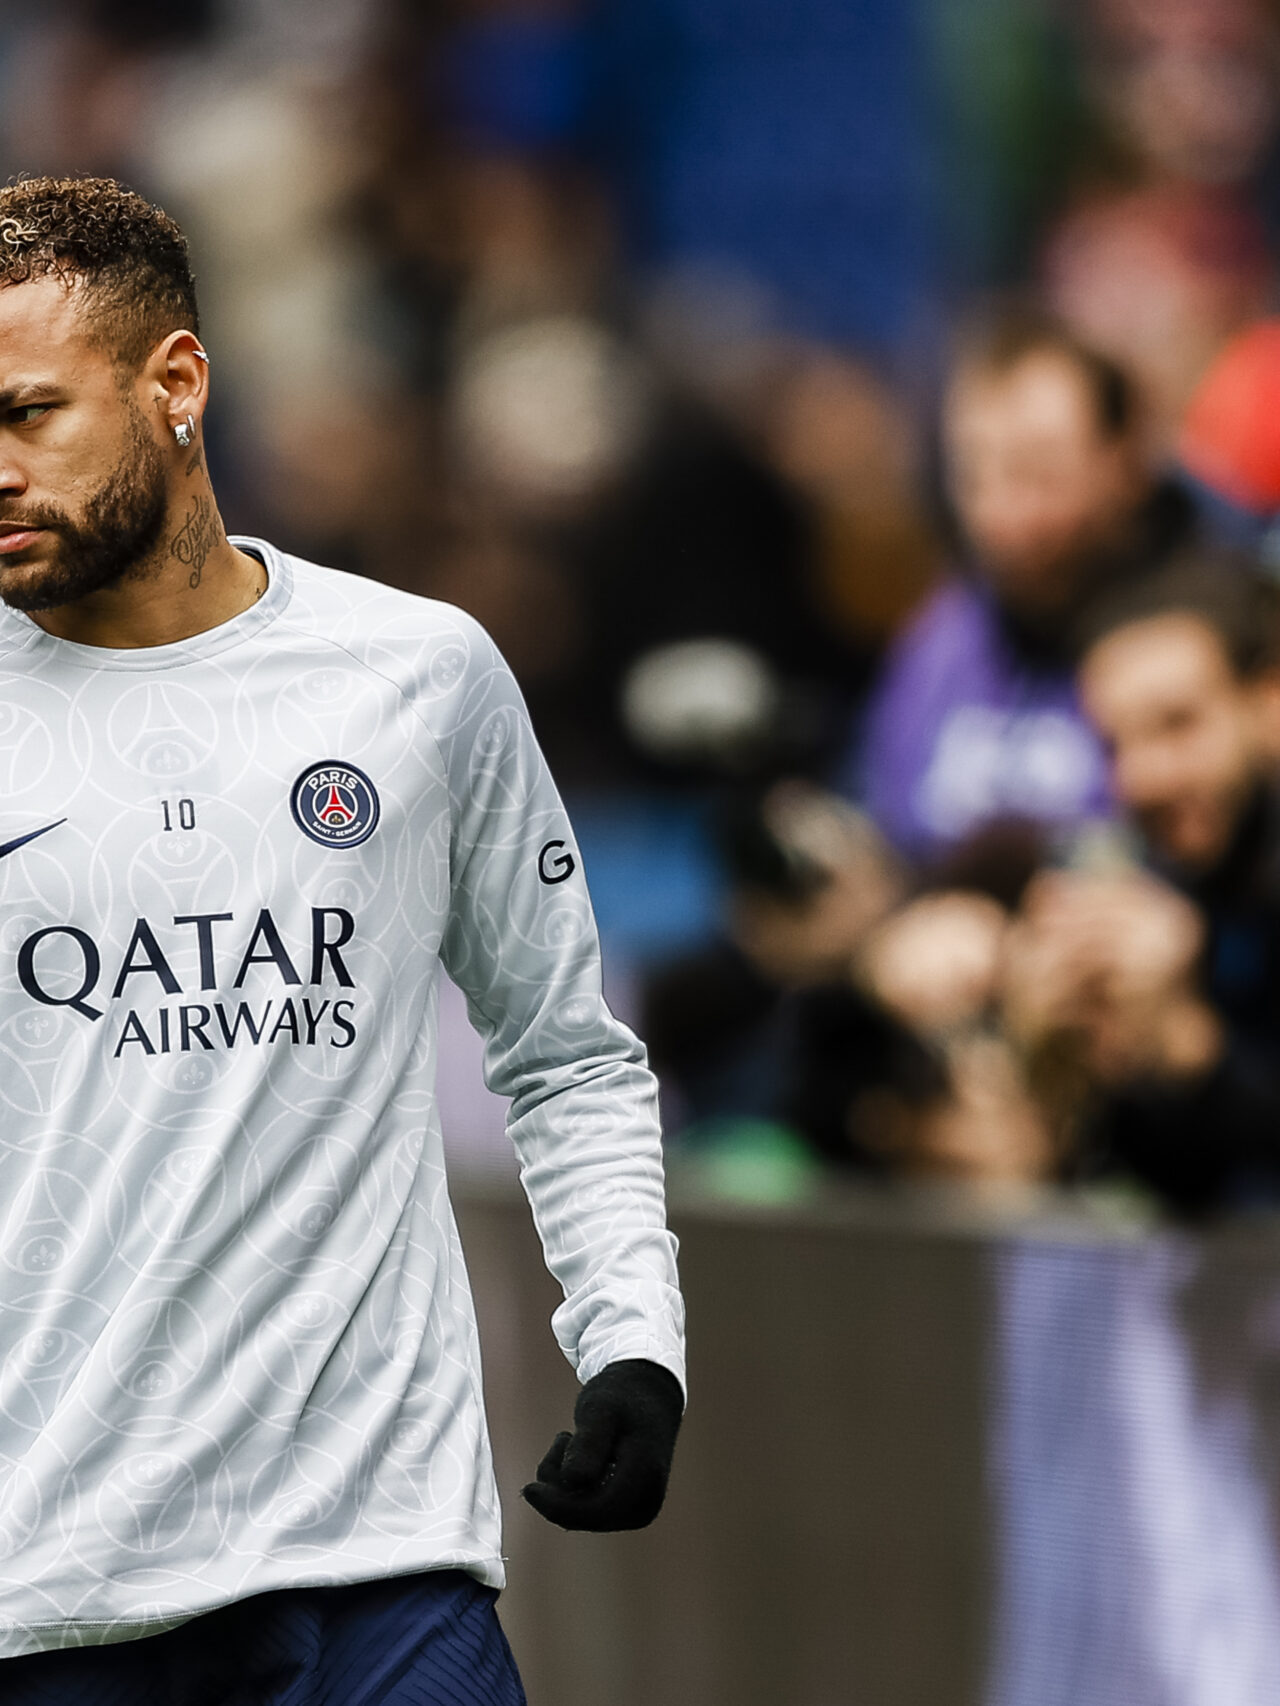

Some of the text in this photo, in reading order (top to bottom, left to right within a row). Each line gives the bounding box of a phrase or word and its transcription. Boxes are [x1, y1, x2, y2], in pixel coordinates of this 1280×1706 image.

[307, 771, 358, 791] PARIS
[160, 798, 196, 832] 10
[18, 908, 356, 1022] QATAR
[114, 998, 356, 1058] AIRWAYS
